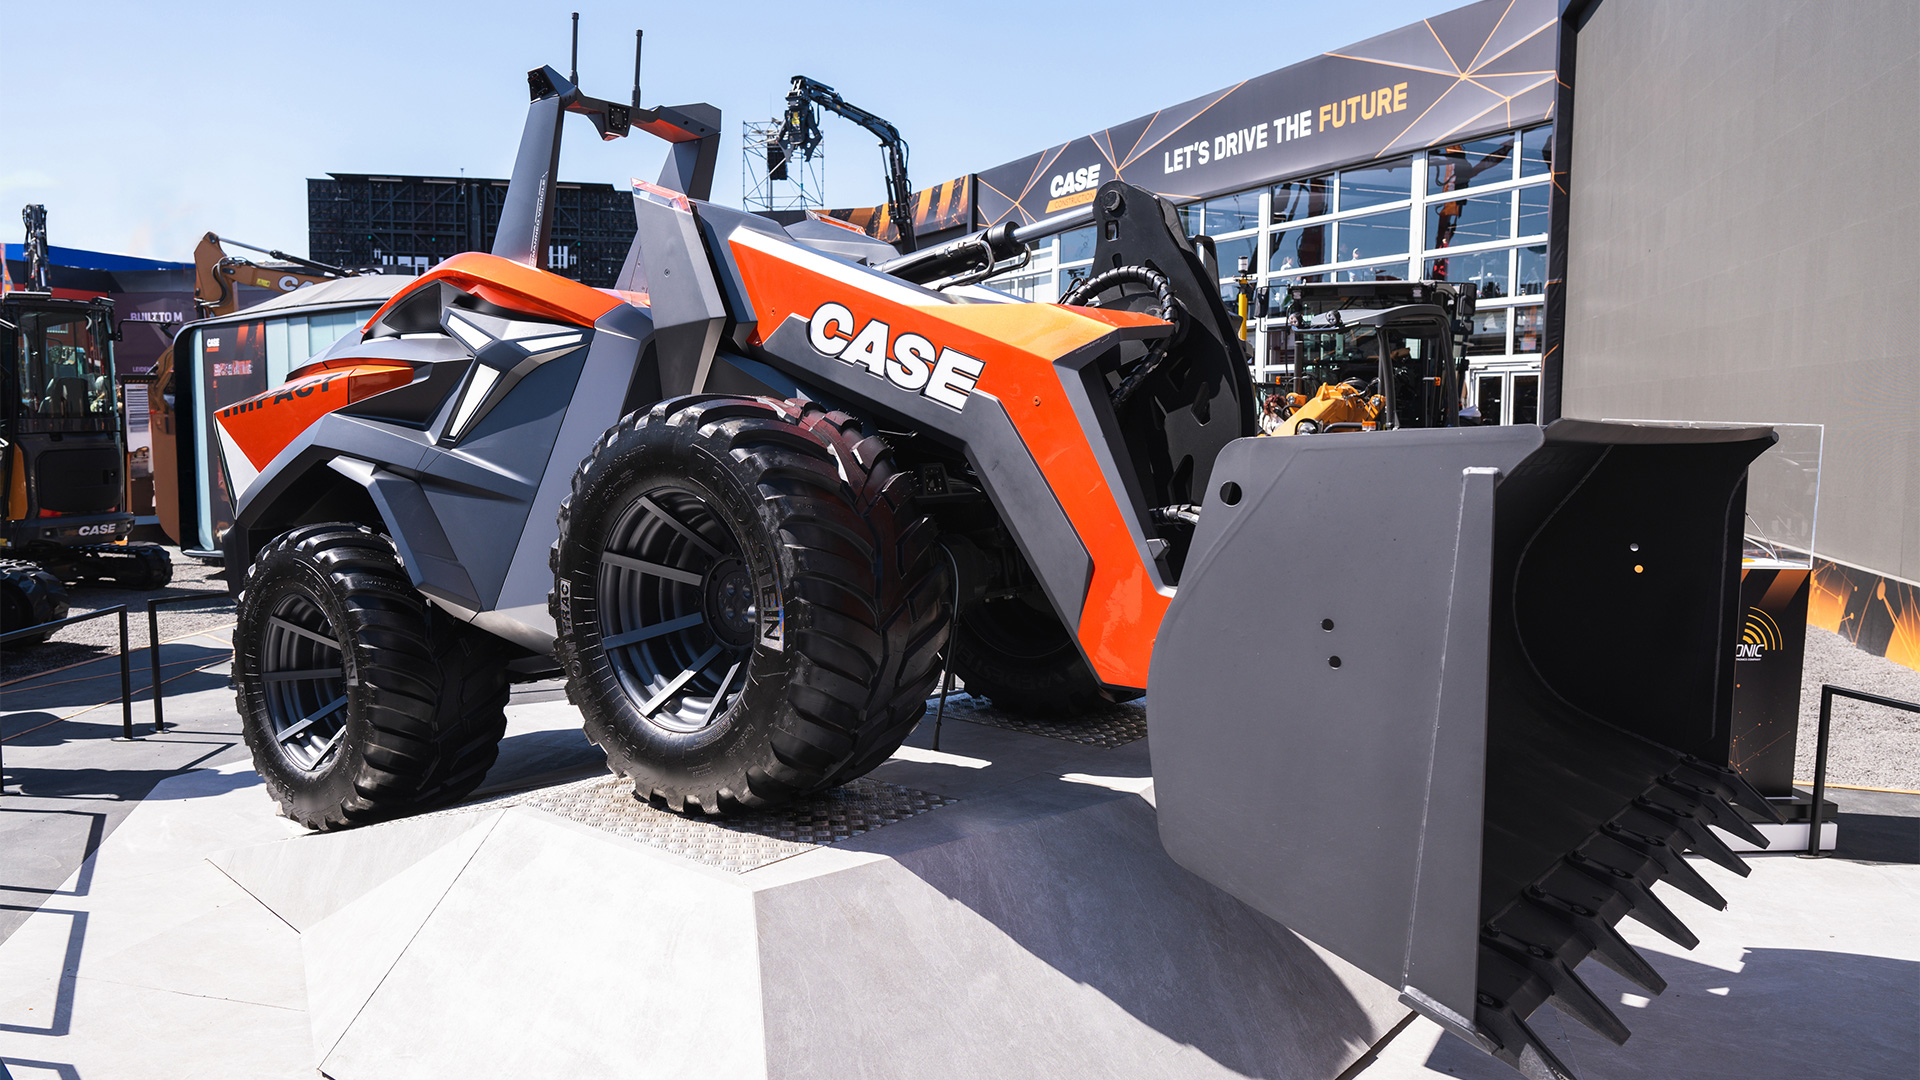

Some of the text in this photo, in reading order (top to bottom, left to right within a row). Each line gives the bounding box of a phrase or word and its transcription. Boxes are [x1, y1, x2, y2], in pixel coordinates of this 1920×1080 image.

[1164, 82, 1408, 174] LET'S DRIVE THE FUTURE
[537, 179, 546, 218] VEHICLE
[1050, 163, 1101, 198] CASE
[159, 312, 172, 322] TO
[173, 312, 183, 322] M
[808, 301, 987, 413] CASE
[222, 373, 343, 418] IMPACT
[78, 523, 116, 536] CASE
[559, 580, 574, 635] TRAC
